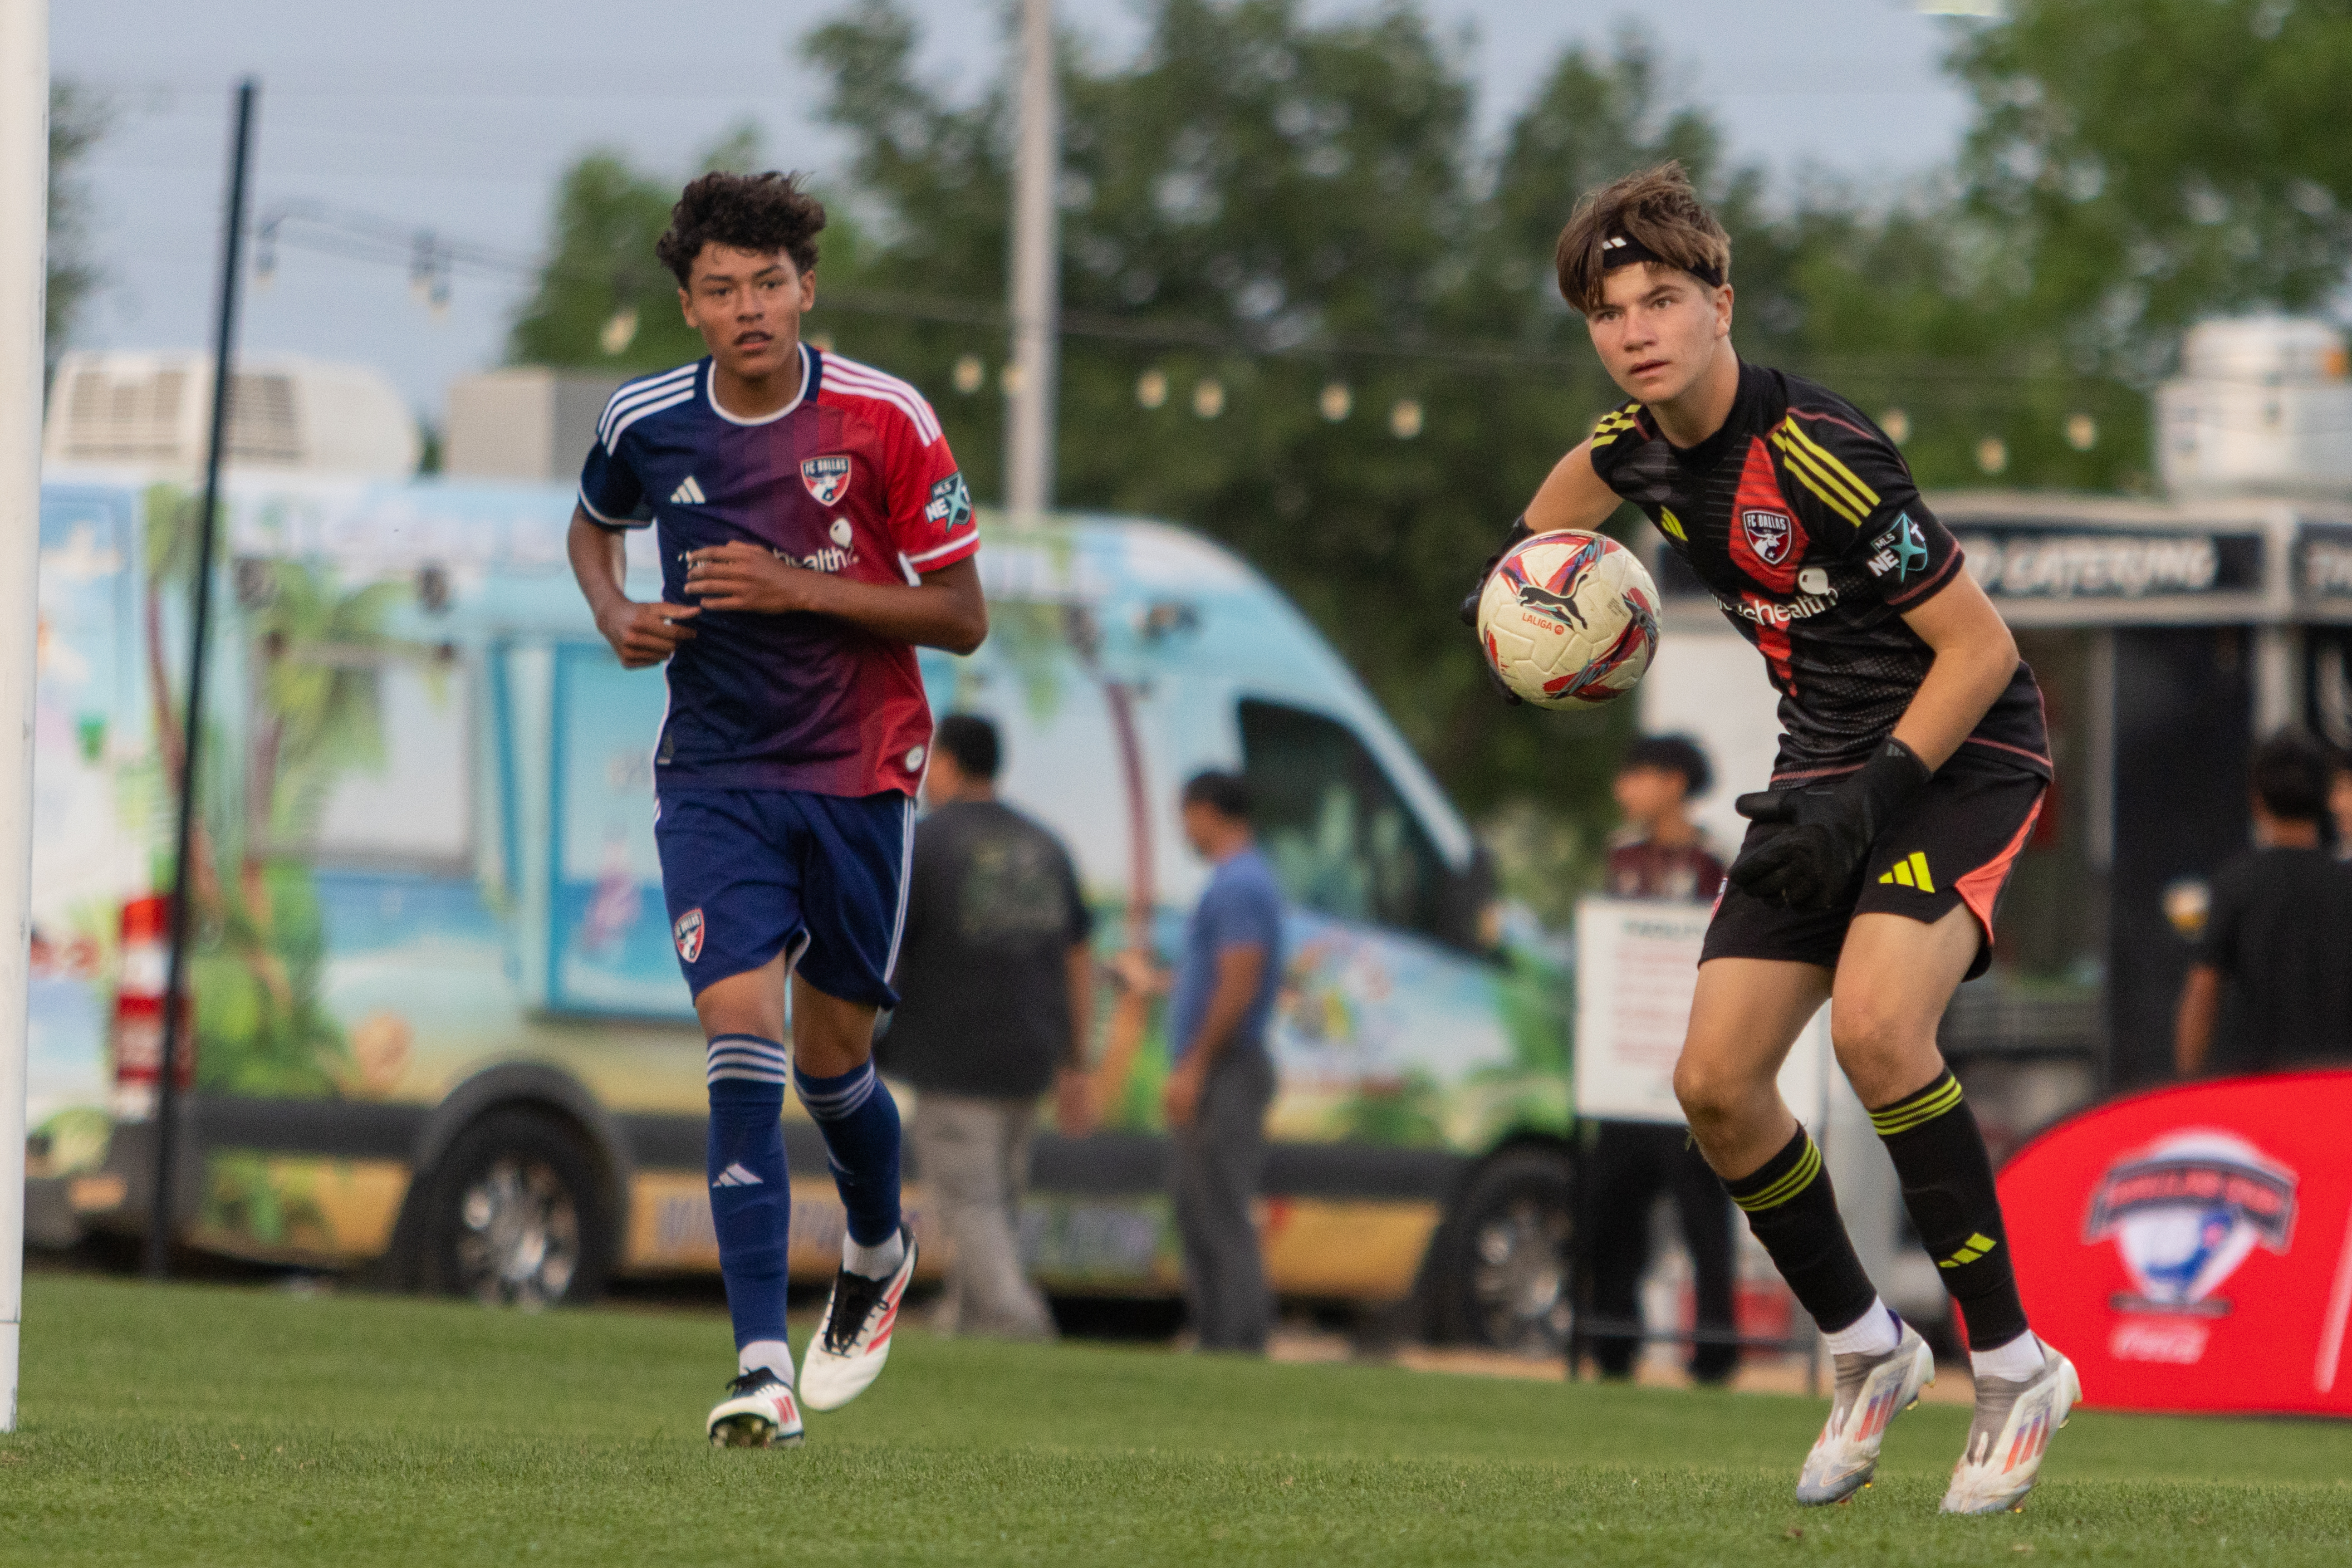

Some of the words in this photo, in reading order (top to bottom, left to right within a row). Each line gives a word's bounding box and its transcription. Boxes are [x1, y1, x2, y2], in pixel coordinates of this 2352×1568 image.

[1747, 514, 1757, 528] FC
[1758, 514, 1787, 530] DALLAS
[1874, 533, 1895, 549] MLS
[1522, 612, 1552, 631] LALIGA
